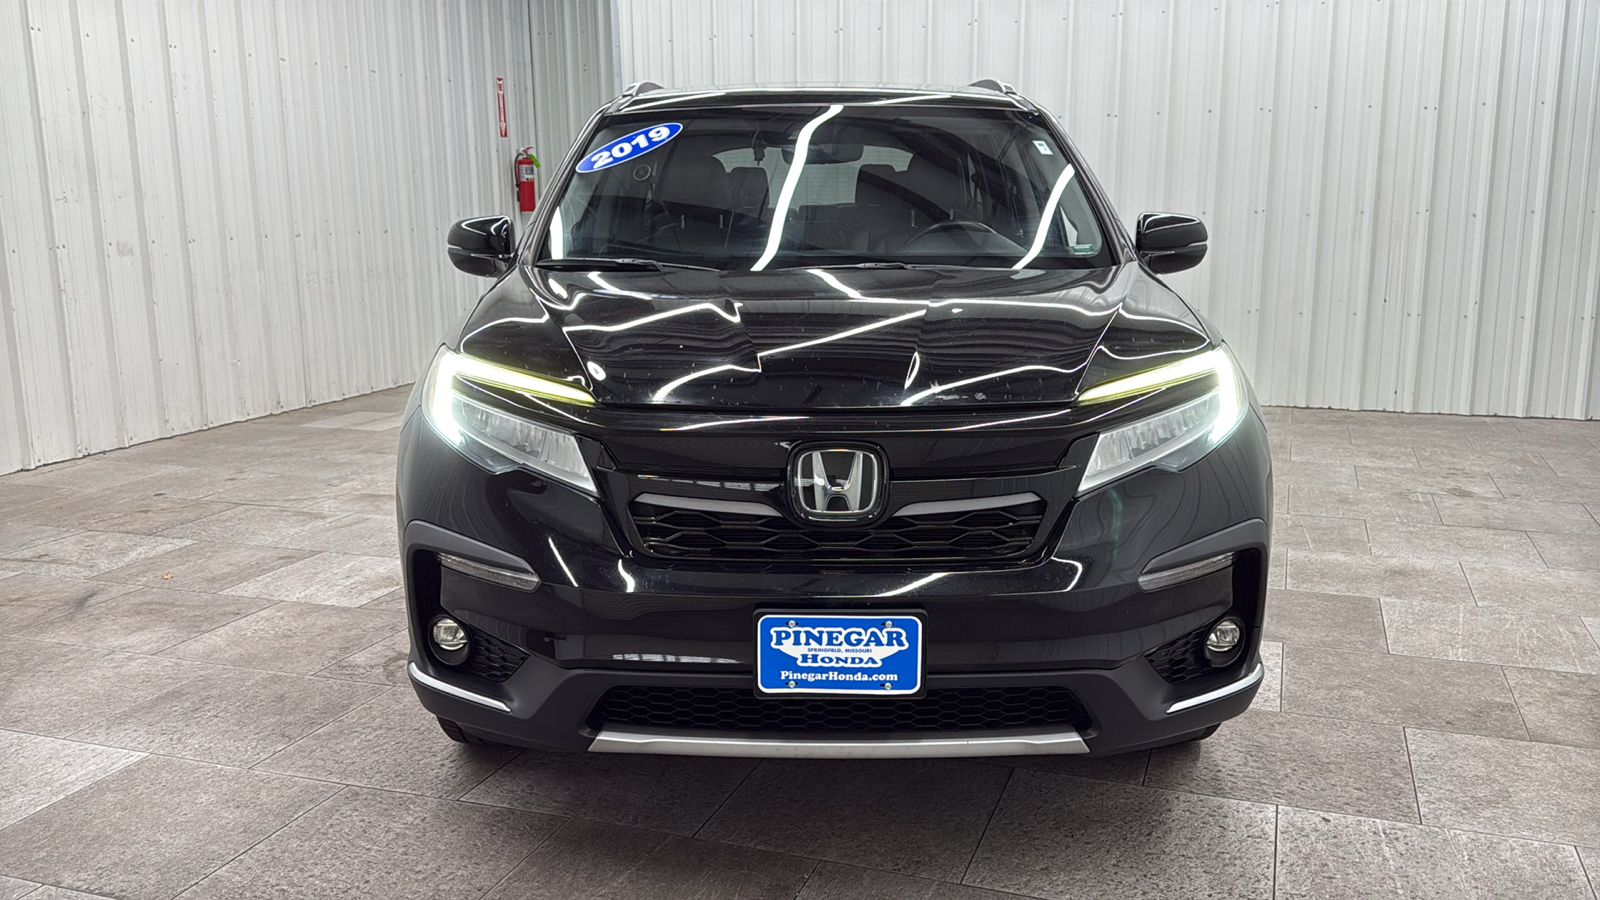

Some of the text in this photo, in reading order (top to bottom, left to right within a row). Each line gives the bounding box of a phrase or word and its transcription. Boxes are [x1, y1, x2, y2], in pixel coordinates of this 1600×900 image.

[591, 126, 671, 169] 2019
[773, 630, 906, 647] PINEGAR
[800, 654, 879, 664] HONDA
[780, 670, 898, 682] PinegarHonda.com
